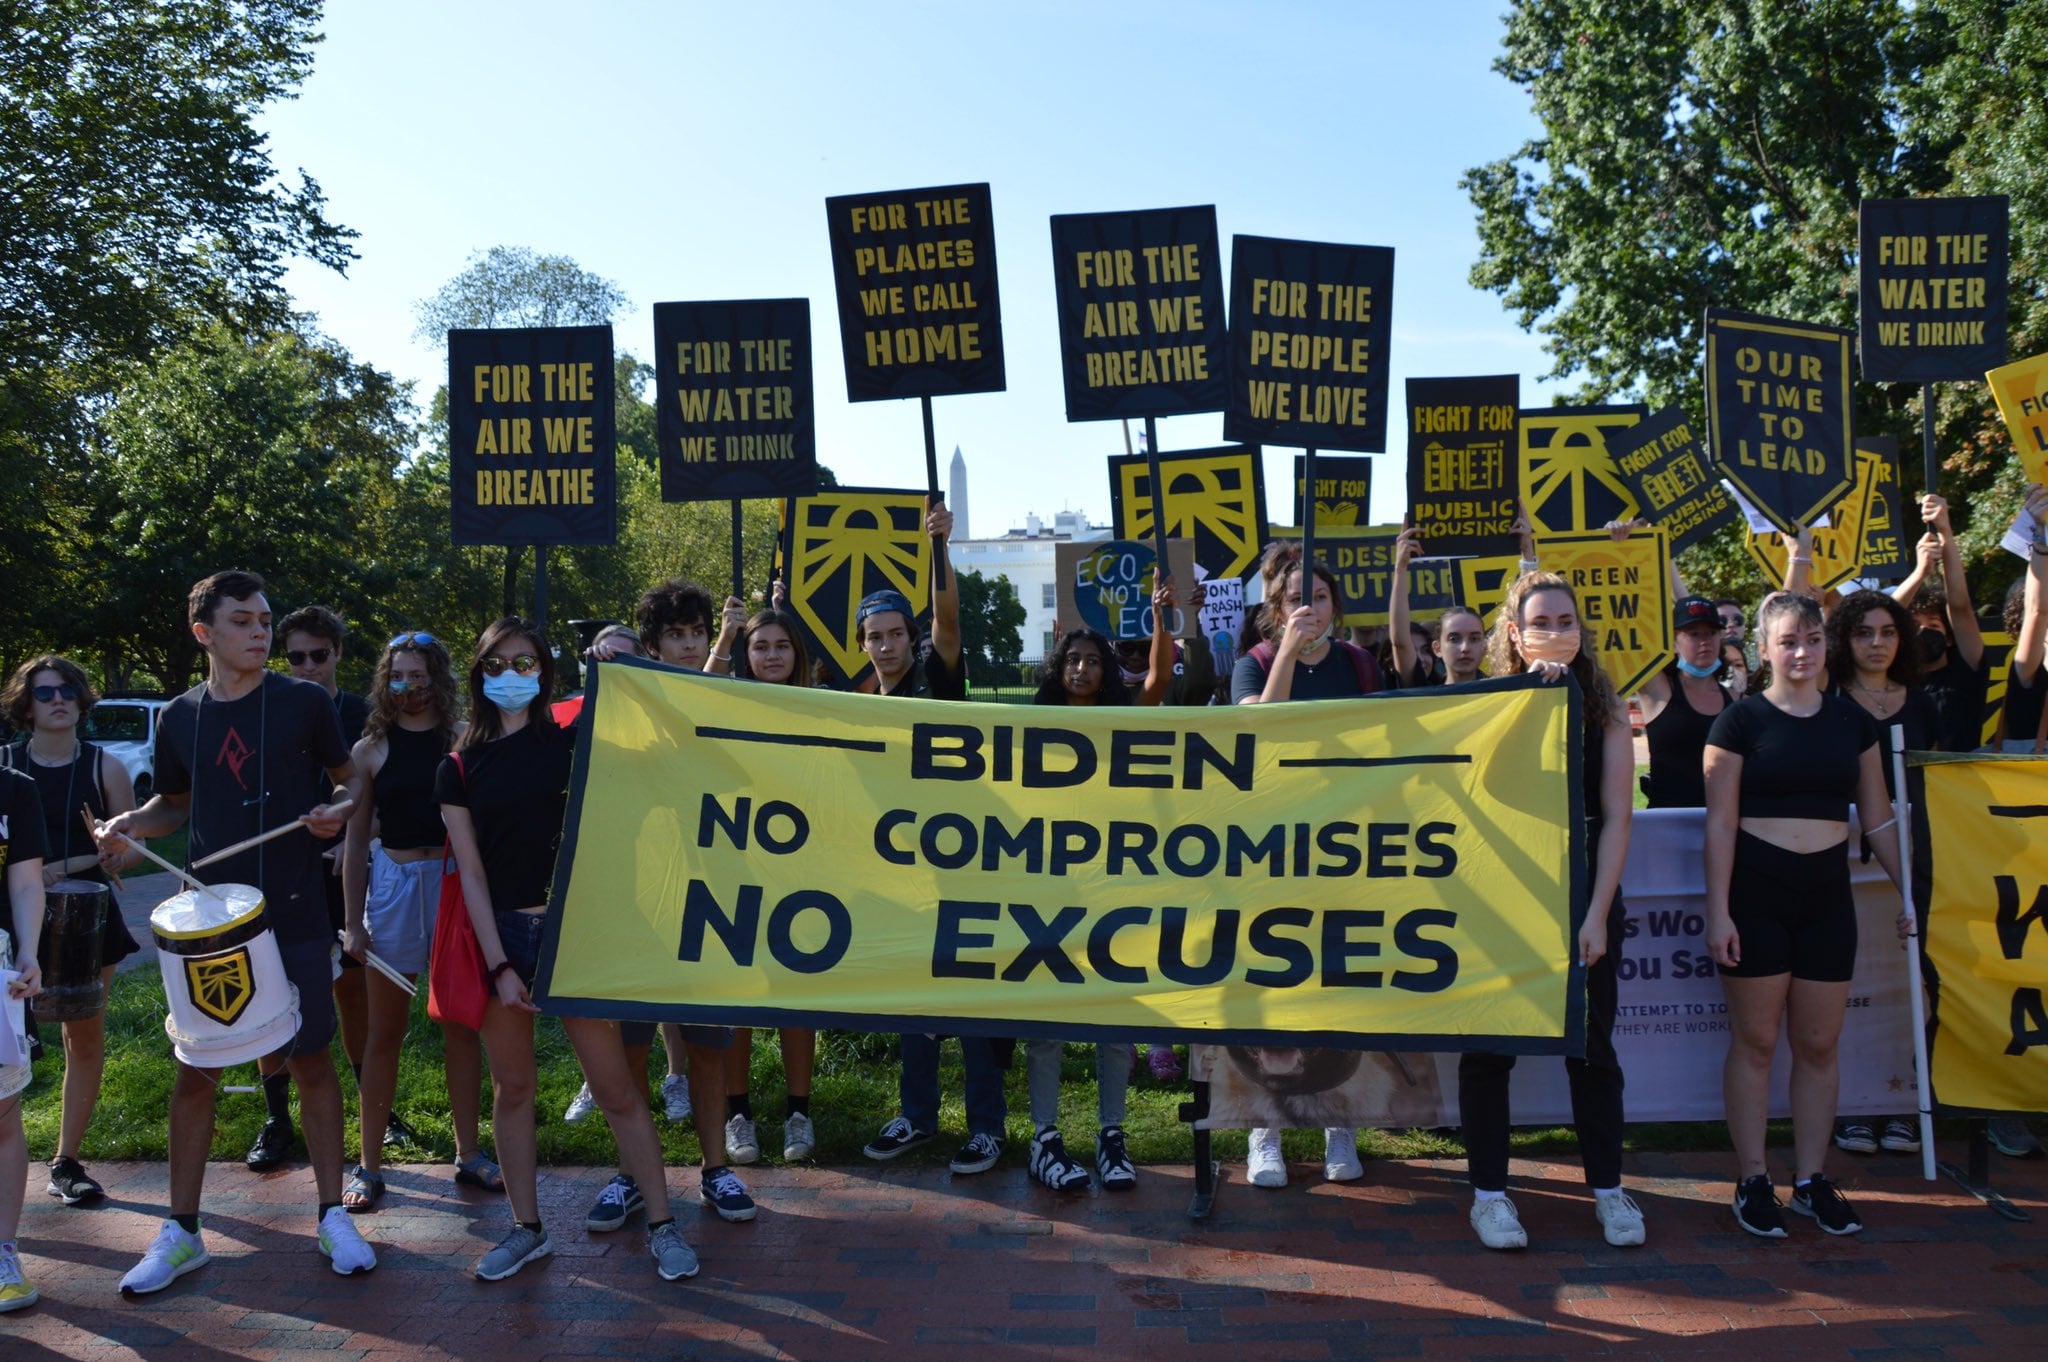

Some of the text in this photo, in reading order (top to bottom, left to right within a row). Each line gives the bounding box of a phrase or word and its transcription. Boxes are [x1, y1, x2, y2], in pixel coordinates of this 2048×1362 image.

[850, 198, 971, 234] FOR THE
[855, 239, 975, 276] PLACES
[1076, 243, 1201, 289] FOR THE
[1878, 234, 1988, 266] FOR THE
[860, 281, 977, 317] WE CALL
[1252, 278, 1372, 323] FOR THE
[1878, 277, 1986, 310] WATER
[1083, 295, 1204, 339] AIR WE
[1878, 321, 1985, 347] WE DRINK
[677, 338, 793, 375] FOR THE
[865, 322, 983, 367] HOME
[1250, 330, 1369, 374] PEOPLE
[1086, 345, 1209, 388] BREATHE
[1735, 346, 1823, 382] OUR
[474, 362, 594, 403] FOR THE
[1736, 379, 1823, 413] TIME
[678, 386, 794, 423] WATER
[1248, 379, 1368, 426] WE LOVE
[1415, 405, 1515, 433] FIGHT FOR
[475, 416, 594, 456] AIR WE
[1758, 412, 1804, 442] TO
[680, 433, 795, 464] WE DRINK
[1619, 424, 1693, 477] FIGHT FOR
[1738, 439, 1827, 476] LEAD
[475, 468, 595, 506] BREATHE
[1341, 480, 1367, 498] FOR
[1415, 499, 1514, 521] PUBLIC
[1415, 519, 1512, 539] HOUSING
[1864, 537, 1899, 552] LIC
[1075, 553, 1137, 588] ECO
[1860, 552, 1900, 566] NSIT
[1099, 584, 1145, 605] NOT
[1203, 599, 1243, 614] TRASH
[1584, 593, 1640, 621] EW
[910, 722, 1255, 792] BIDEN
[696, 793, 1458, 879] NO COMPROMISES
[677, 879, 1459, 992] NO EXCUSES
[1648, 910, 1705, 937] Wo
[1617, 949, 1716, 981] ou Sa
[1684, 1003, 1704, 1016] TO
[1654, 1022, 1681, 1034] ARE
